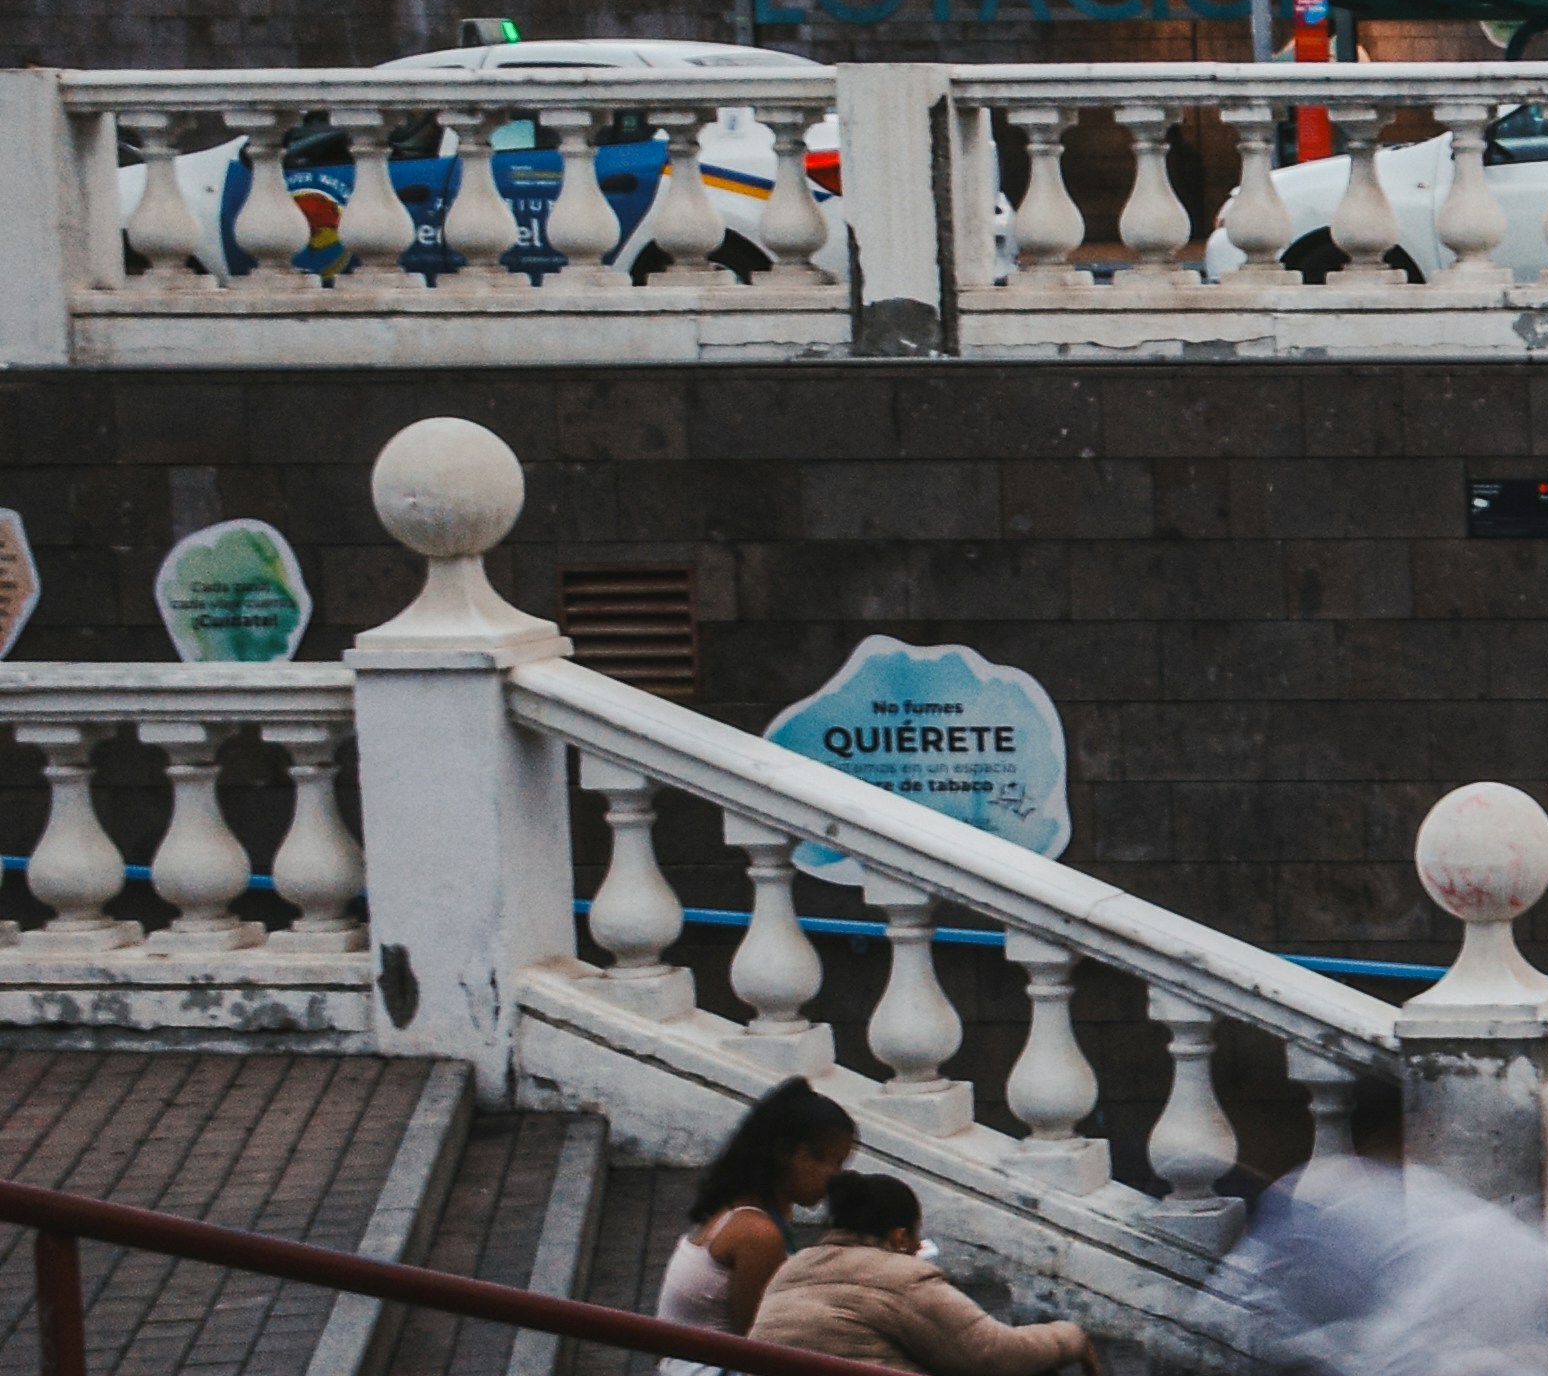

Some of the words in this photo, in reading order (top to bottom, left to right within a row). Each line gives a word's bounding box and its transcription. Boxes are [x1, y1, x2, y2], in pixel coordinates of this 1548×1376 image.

[872, 700, 898, 715] No
[904, 699, 964, 715] fumes
[823, 720, 1016, 758] QUIÉRETE
[902, 763, 922, 775] en
[954, 762, 1017, 777] espacio
[900, 779, 923, 792] de
[928, 778, 994, 793] tabaco
